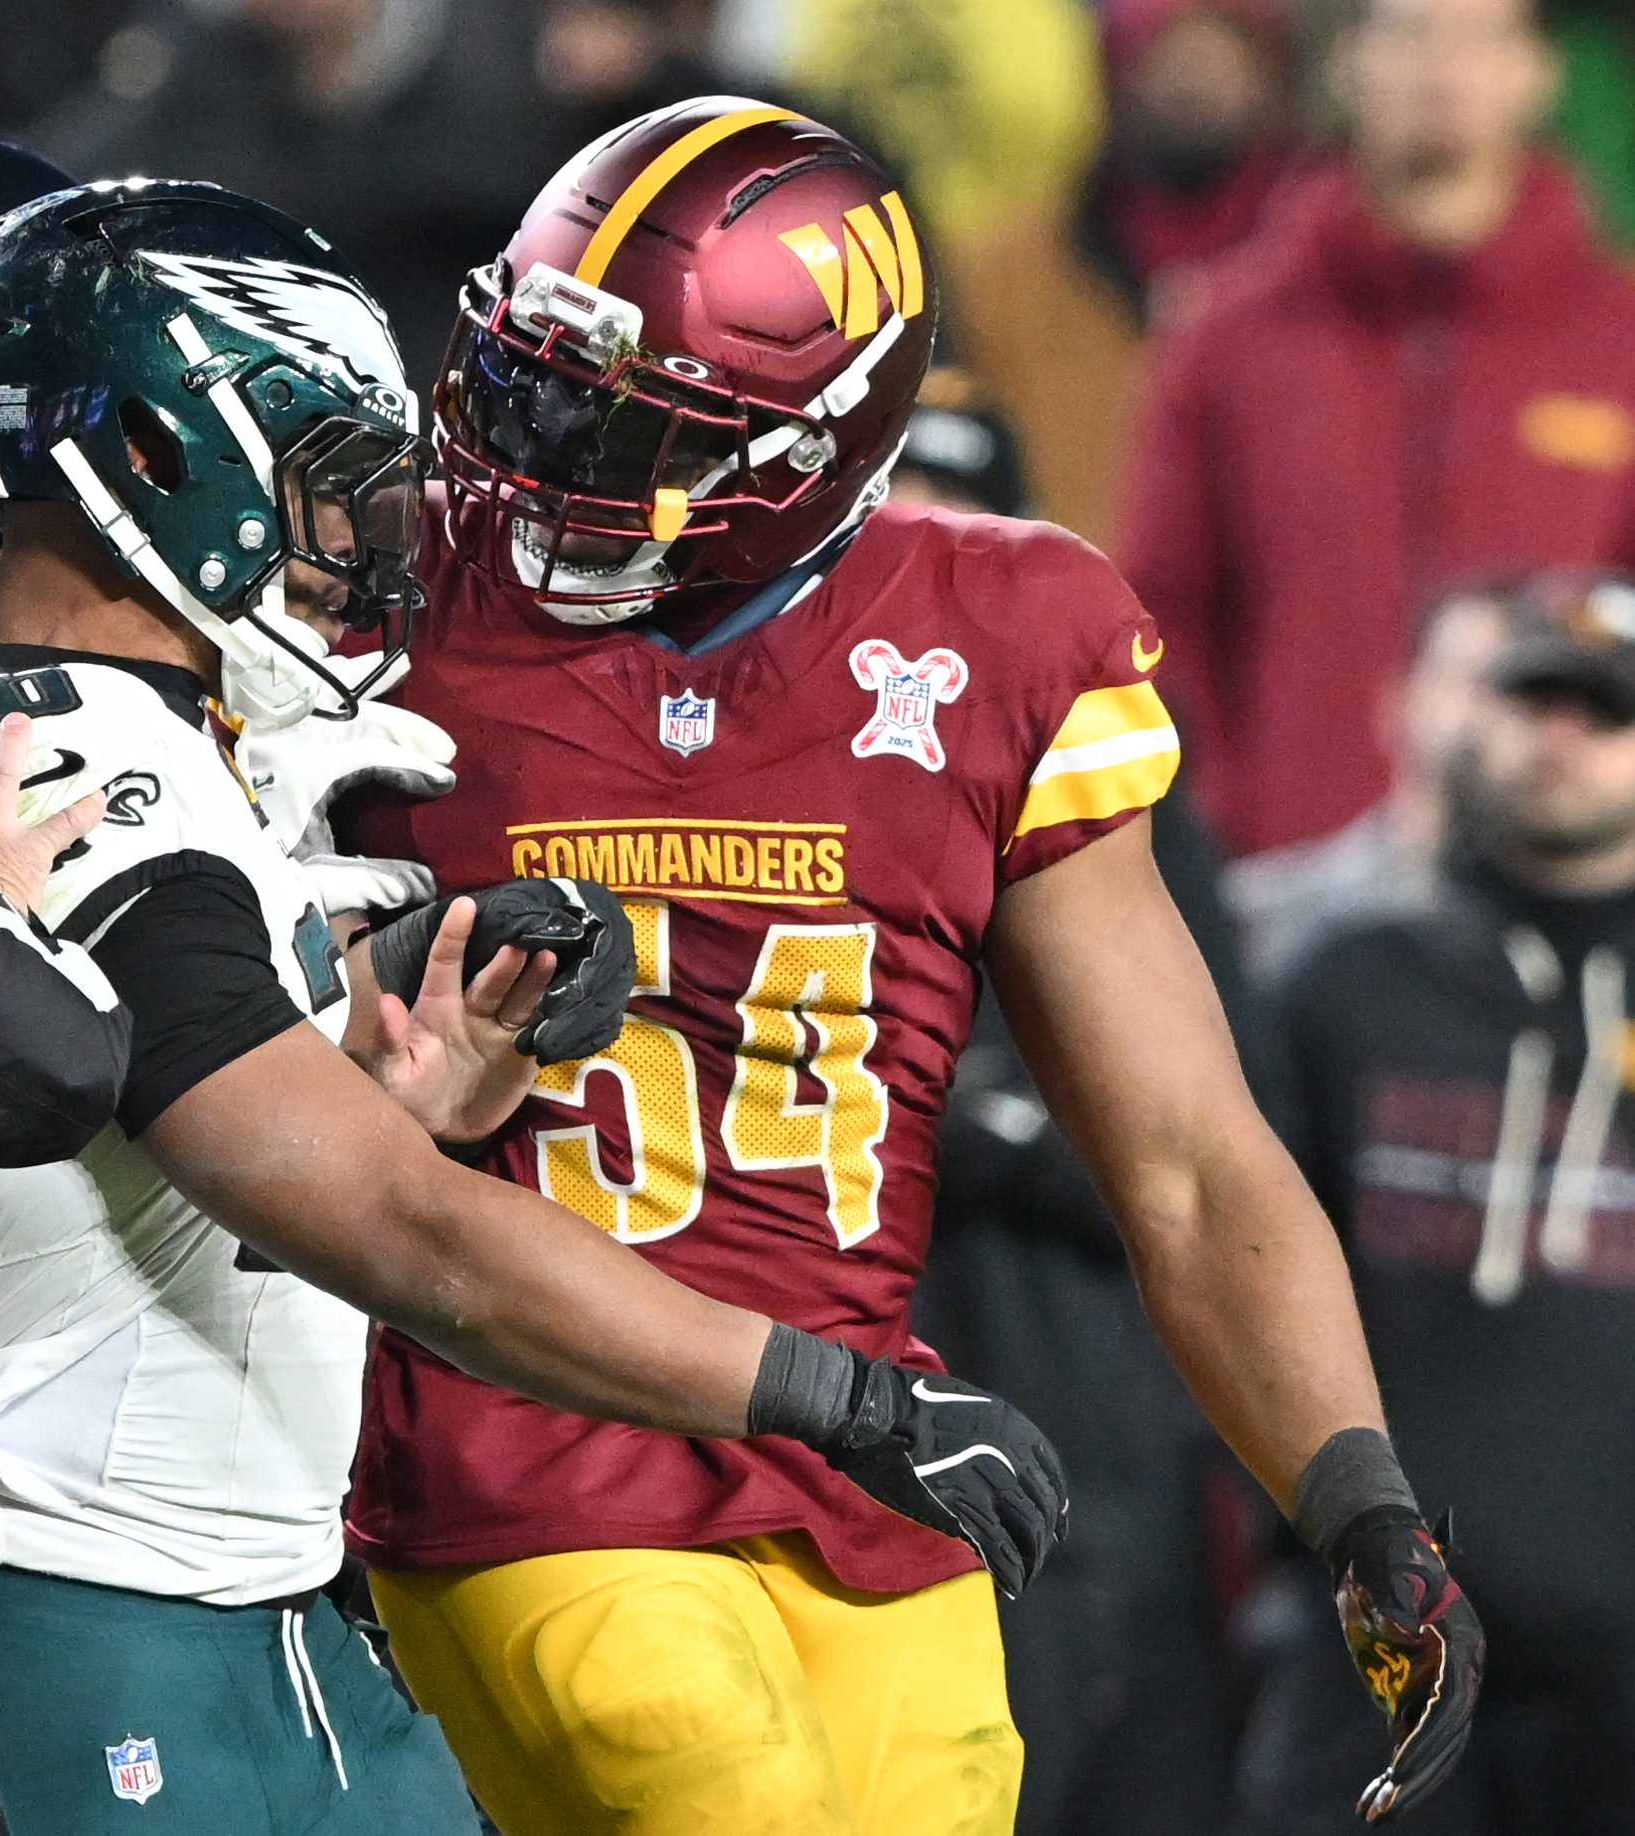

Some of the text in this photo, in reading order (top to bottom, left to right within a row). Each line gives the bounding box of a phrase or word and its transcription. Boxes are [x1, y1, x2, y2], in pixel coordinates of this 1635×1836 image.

[363, 398, 405, 427] OAKLEY
[887, 696, 922, 724] NFL
[668, 720, 701, 743] NFL
[887, 736, 913, 748] 2025
[512, 833, 845, 893] COMMANDERS
[528, 900, 890, 1251] 54
[118, 1764, 154, 1790] NFL
